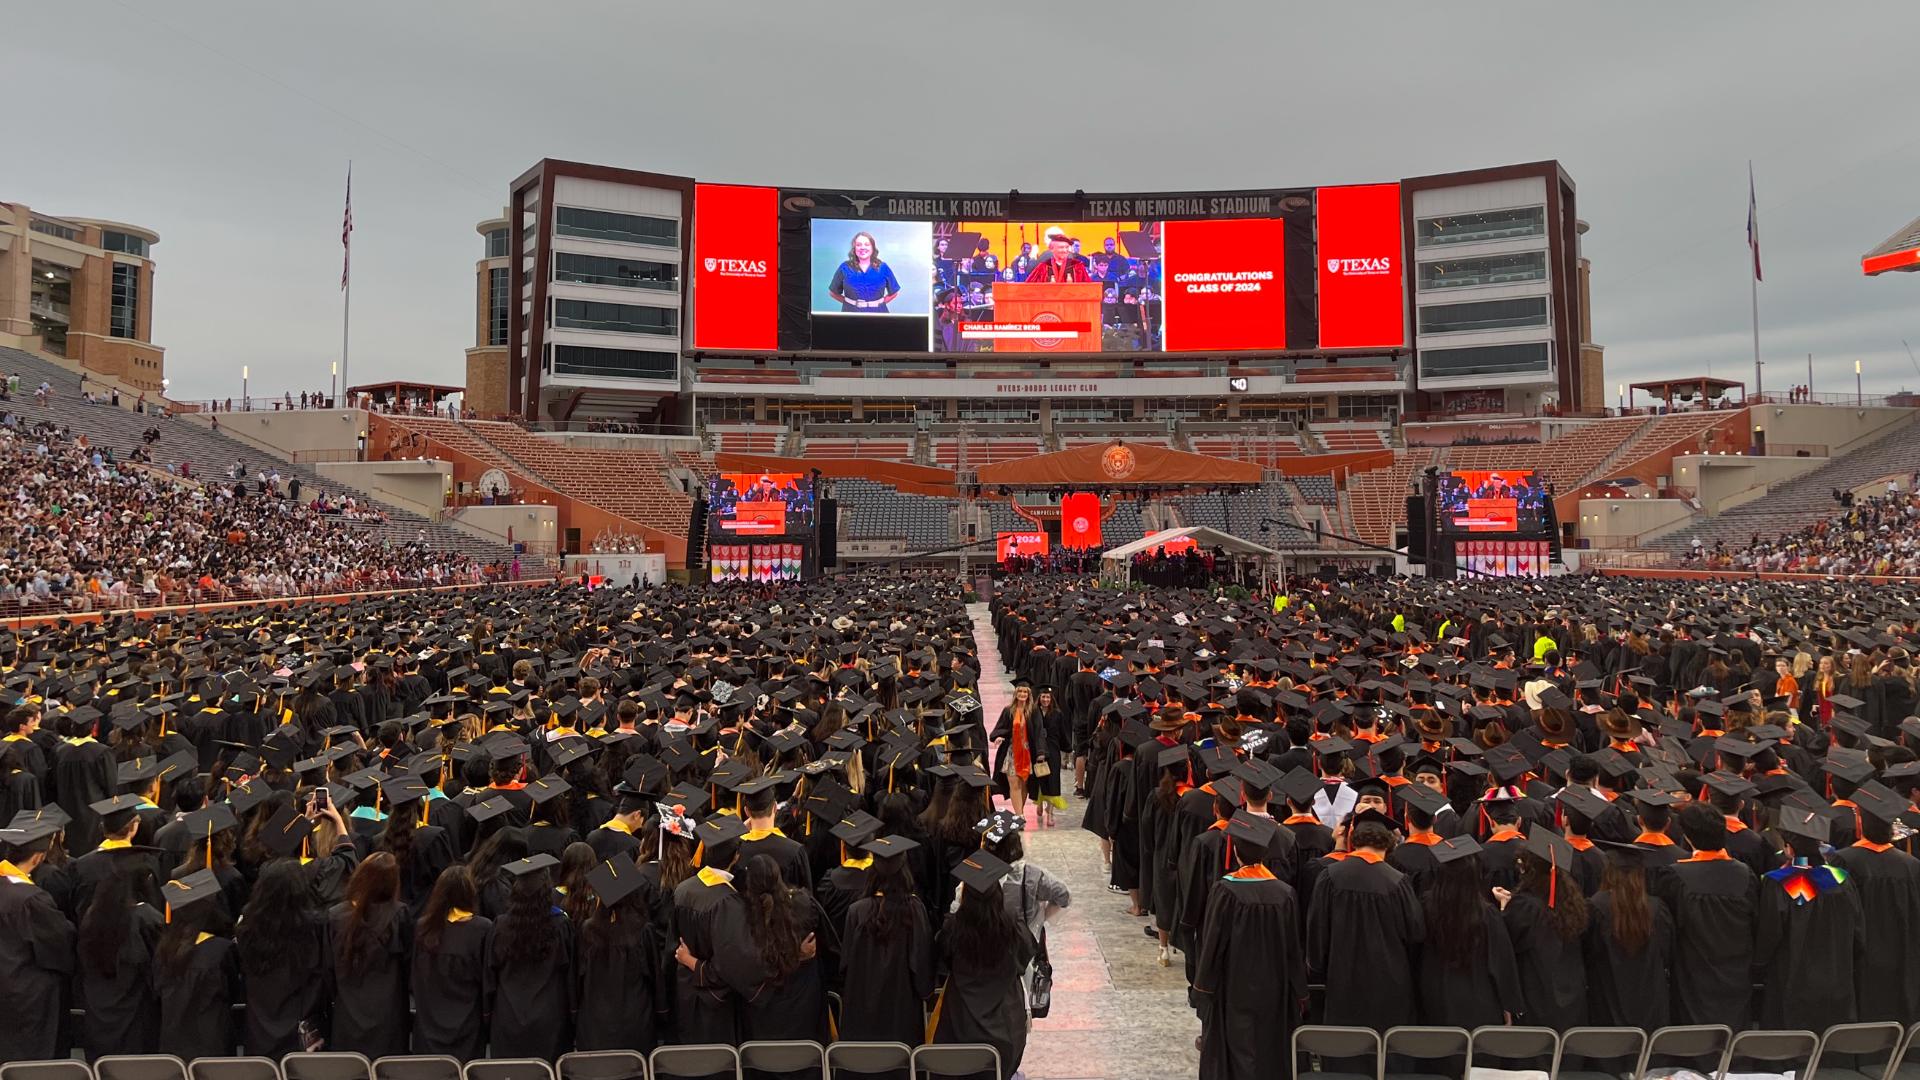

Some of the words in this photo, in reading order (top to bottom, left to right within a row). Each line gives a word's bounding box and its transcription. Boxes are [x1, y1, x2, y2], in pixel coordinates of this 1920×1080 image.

[888, 199, 946, 216] DARRELL
[950, 200, 959, 216] K
[963, 200, 1004, 217] ROYAL
[1089, 200, 1131, 217] TEXAS
[1135, 199, 1206, 216] MEMORIAL
[1210, 196, 1270, 214] STADIUM
[717, 258, 767, 273] TEXAS
[1340, 257, 1391, 272] TEXAS
[1174, 271, 1274, 282] CONGRATULATIONS
[1186, 283, 1219, 293] CLASS
[1220, 283, 1233, 292] OF
[1235, 282, 1261, 292] 2024
[963, 323, 993, 331] CHARLES
[1023, 323, 1041, 331] BERG
[1050, 384, 1077, 392] LEGACY
[1079, 384, 1098, 392] CLUB
[1016, 535, 1041, 543] 2024
